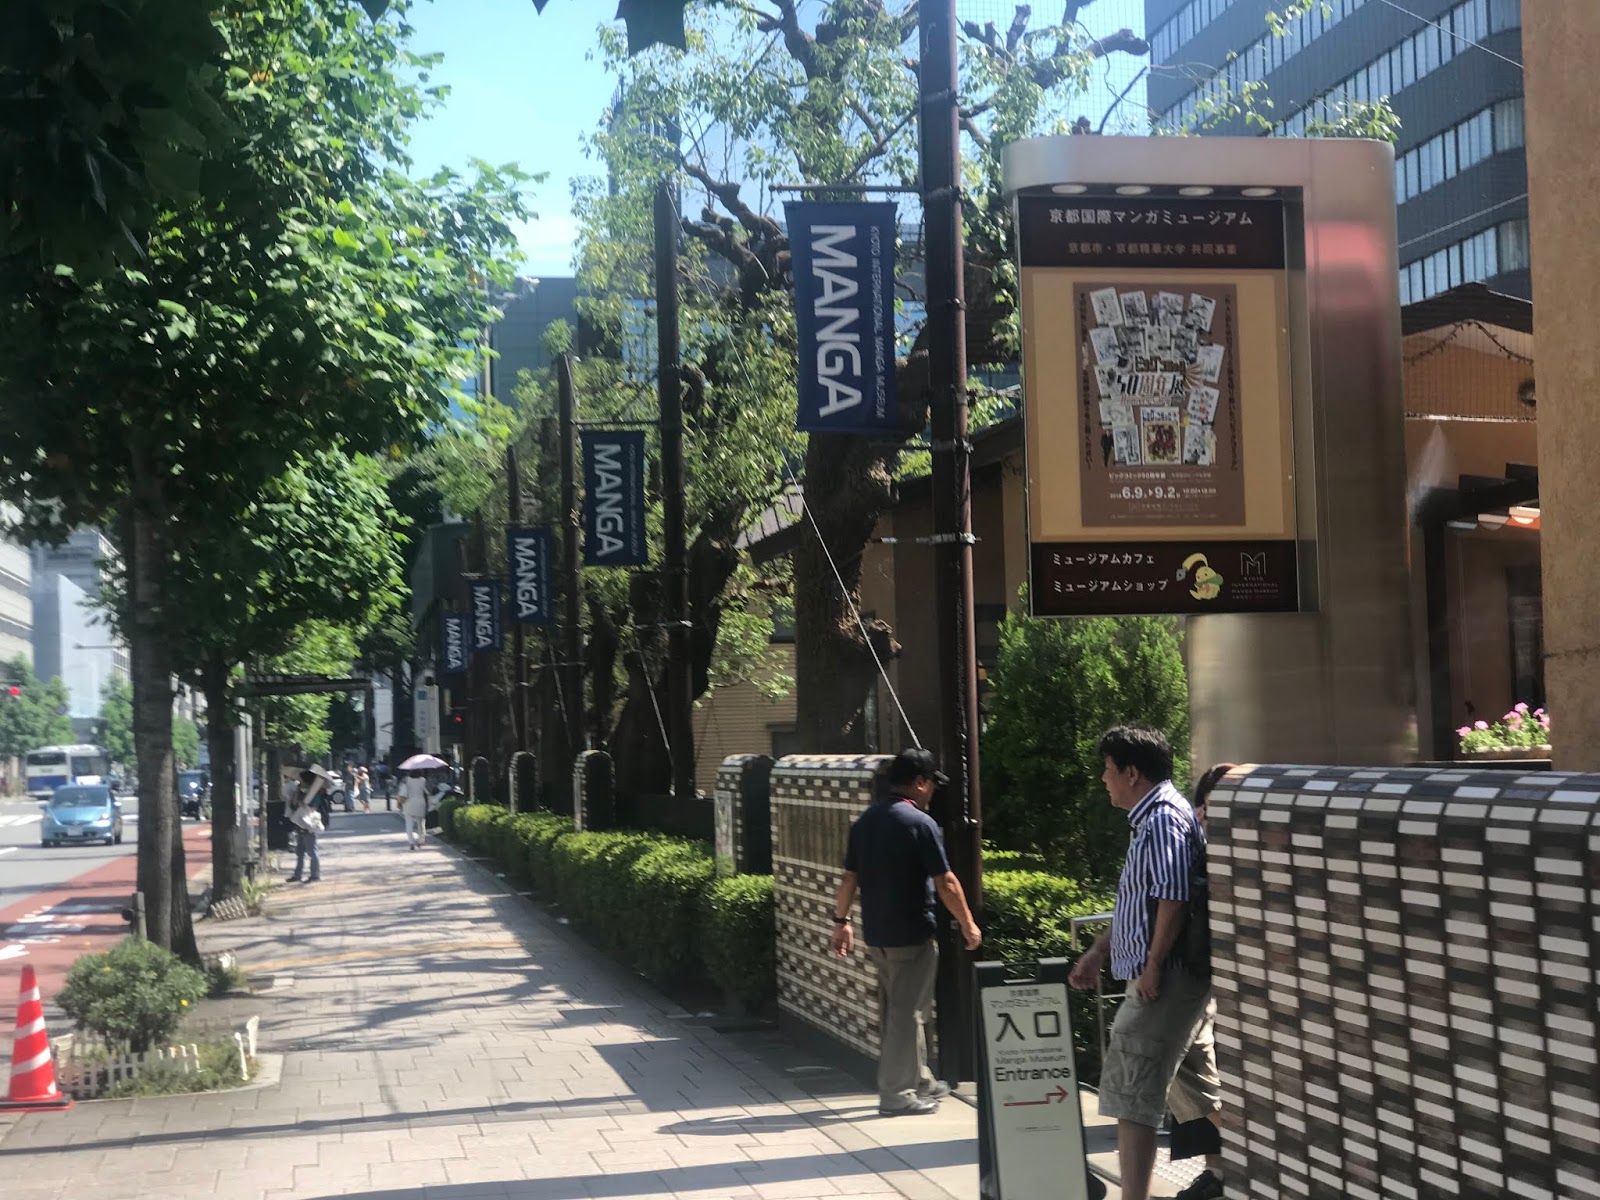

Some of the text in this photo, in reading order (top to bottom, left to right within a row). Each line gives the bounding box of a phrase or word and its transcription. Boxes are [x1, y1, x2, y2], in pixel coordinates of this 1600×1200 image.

[1049, 208, 1254, 226] 京都国際マンガミュージアム
[809, 224, 863, 419] MANGA
[870, 225, 886, 420] KYOTO INTERNATIONAL MANGA MUSEUM
[593, 443, 625, 557] MANGA
[1121, 485, 1143, 500] 6.9
[1154, 485, 1176, 500] 9.2
[1053, 552, 1155, 566] ミュージアムカフェ
[514, 537, 538, 618] MANGA
[1054, 579, 1168, 593] ミュージアムショップ
[473, 585, 494, 648] MANGA
[446, 618, 463, 669] MANGA
[995, 1010, 1062, 1042] 入口
[994, 1066, 1072, 1083] Entrance
[1029, 1054, 1067, 1063] Museum
